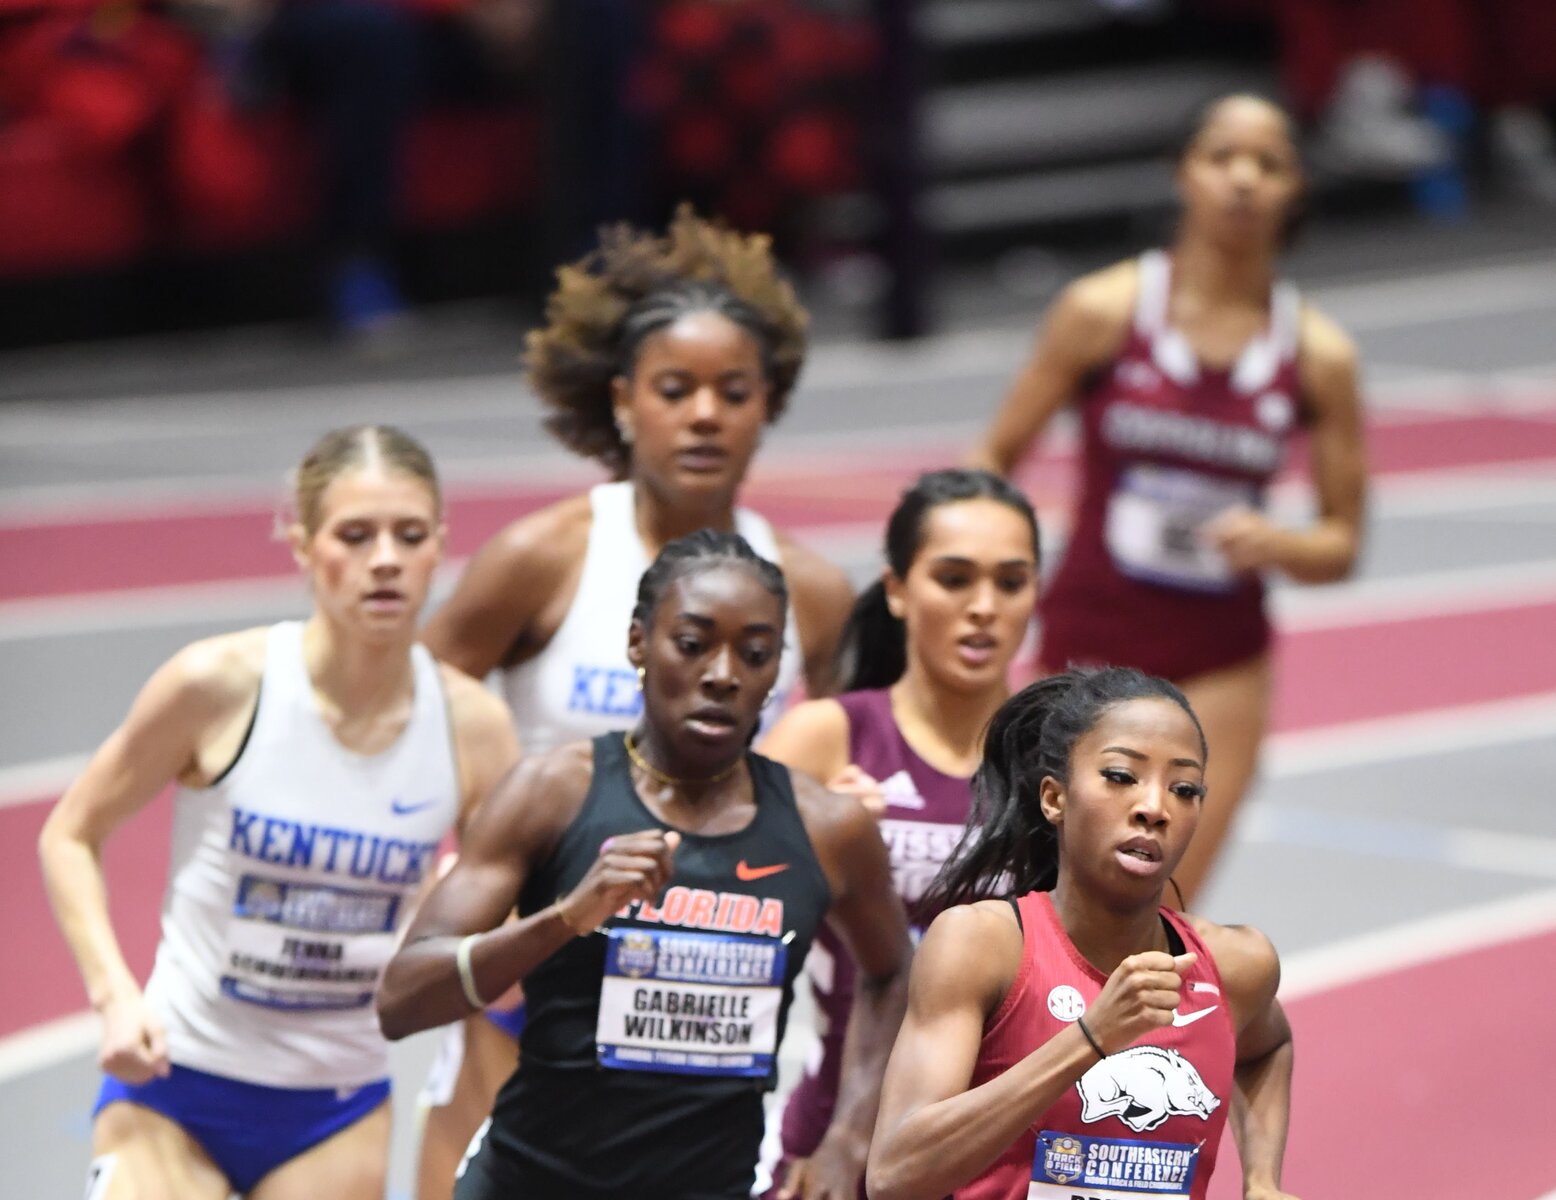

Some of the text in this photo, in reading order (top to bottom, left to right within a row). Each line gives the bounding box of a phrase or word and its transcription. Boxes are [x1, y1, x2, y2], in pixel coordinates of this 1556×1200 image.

[633, 988, 752, 1018] GABRIELLE
[624, 1014, 754, 1045] WILKINSON
[1047, 1151, 1082, 1165] TRACK
[1054, 1161, 1081, 1172] FIELD
[1088, 1143, 1191, 1167] SOUTHEASTERN
[1085, 1160, 1188, 1183] CONFERENCE
